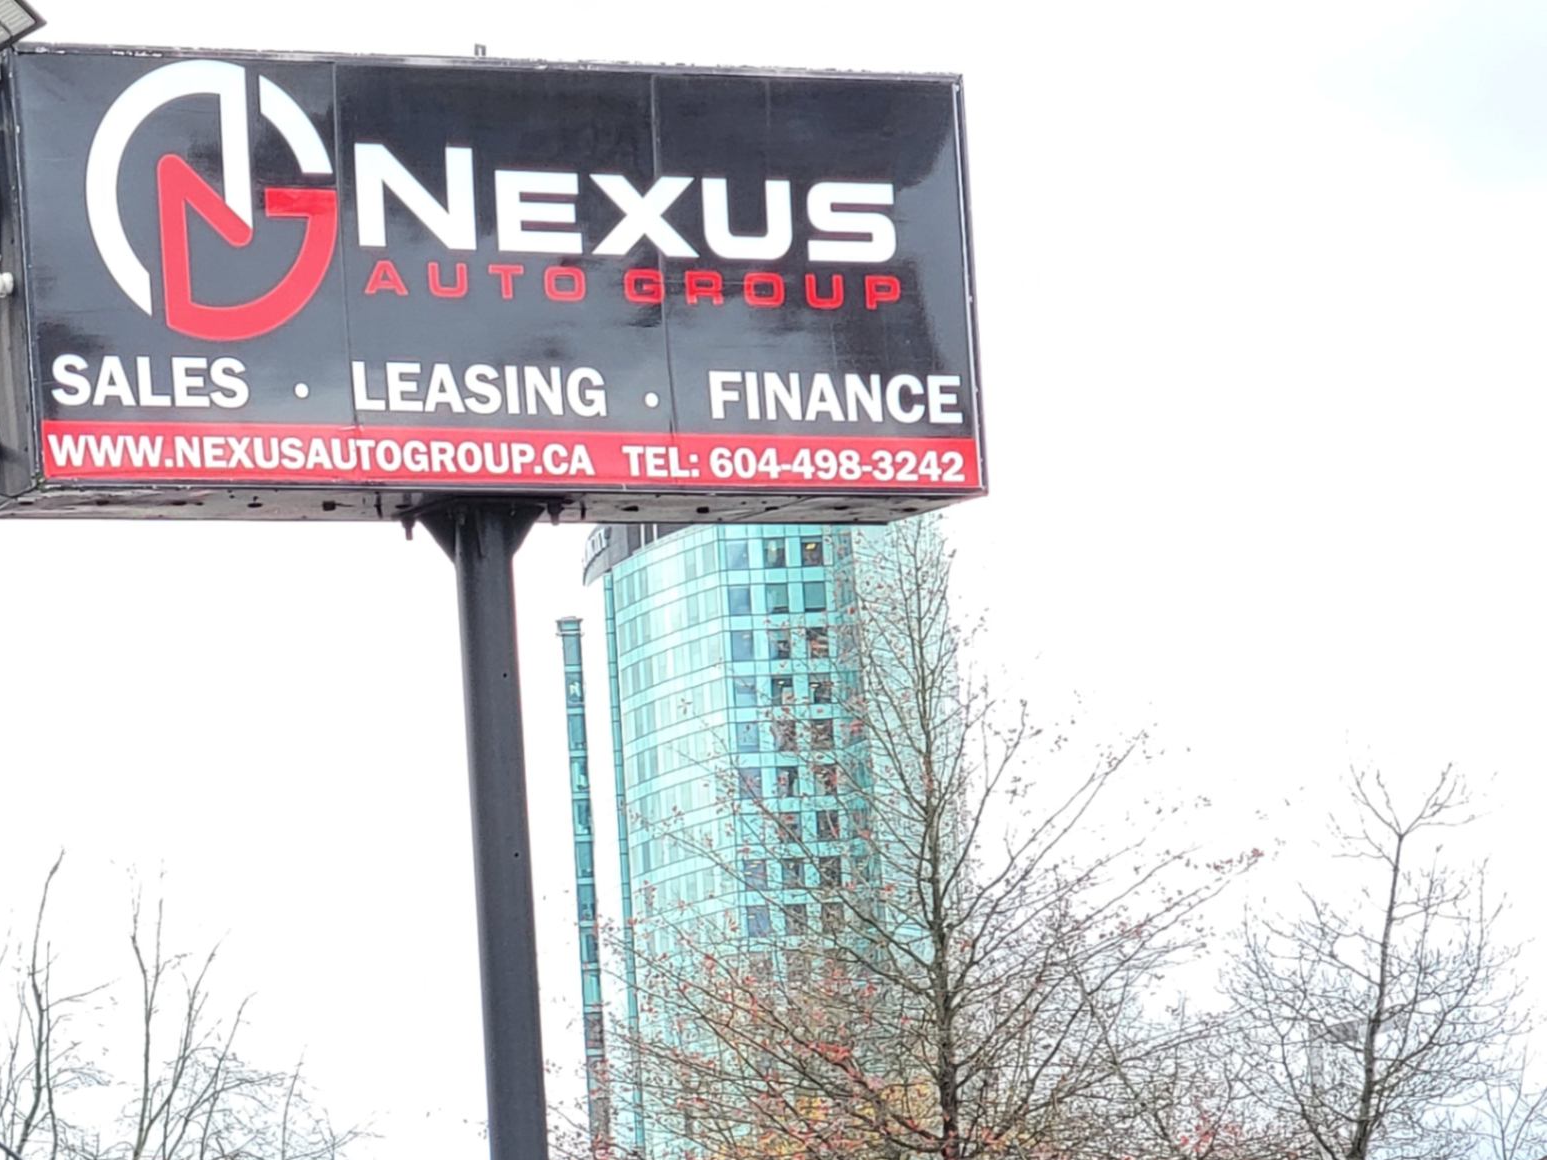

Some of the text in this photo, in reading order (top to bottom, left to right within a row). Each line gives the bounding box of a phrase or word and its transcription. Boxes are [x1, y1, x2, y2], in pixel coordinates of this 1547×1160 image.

[355, 143, 896, 263] NEXUS
[365, 260, 902, 310] AUTO GROUP
[52, 354, 963, 424] SALES LEASING FINANCE
[48, 434, 965, 482] WWW.NEXUSAUTOGROUP.CA TEL: 604-498-3242
